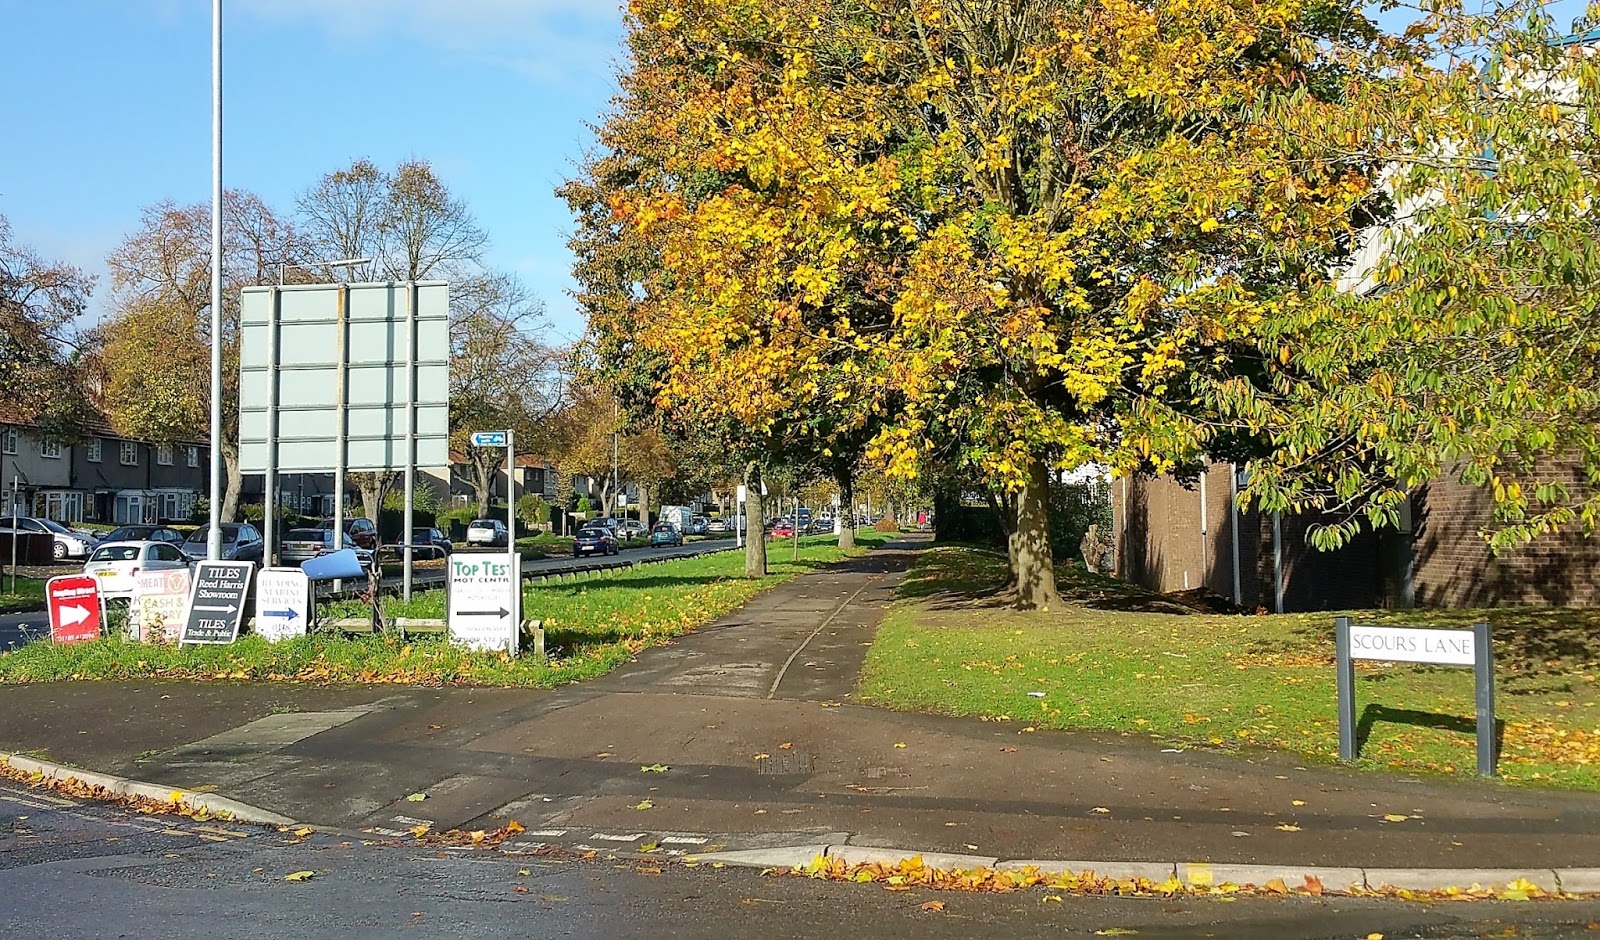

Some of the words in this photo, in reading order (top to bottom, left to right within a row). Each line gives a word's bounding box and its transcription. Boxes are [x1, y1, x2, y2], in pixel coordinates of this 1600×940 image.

[208, 567, 240, 579] TILES
[453, 561, 479, 576] TOP
[482, 561, 510, 576] TES
[140, 577, 165, 589] MEAT
[198, 579, 218, 588] Reed
[219, 580, 244, 589] Harris
[198, 589, 239, 599] Showroom
[144, 598, 174, 608] CASH
[147, 610, 182, 620] CRRY
[198, 619, 226, 629] TILES
[187, 629, 205, 637] Trade
[213, 629, 232, 637] Public
[1353, 634, 1416, 652] SCOURS
[1425, 637, 1470, 654] LANE
